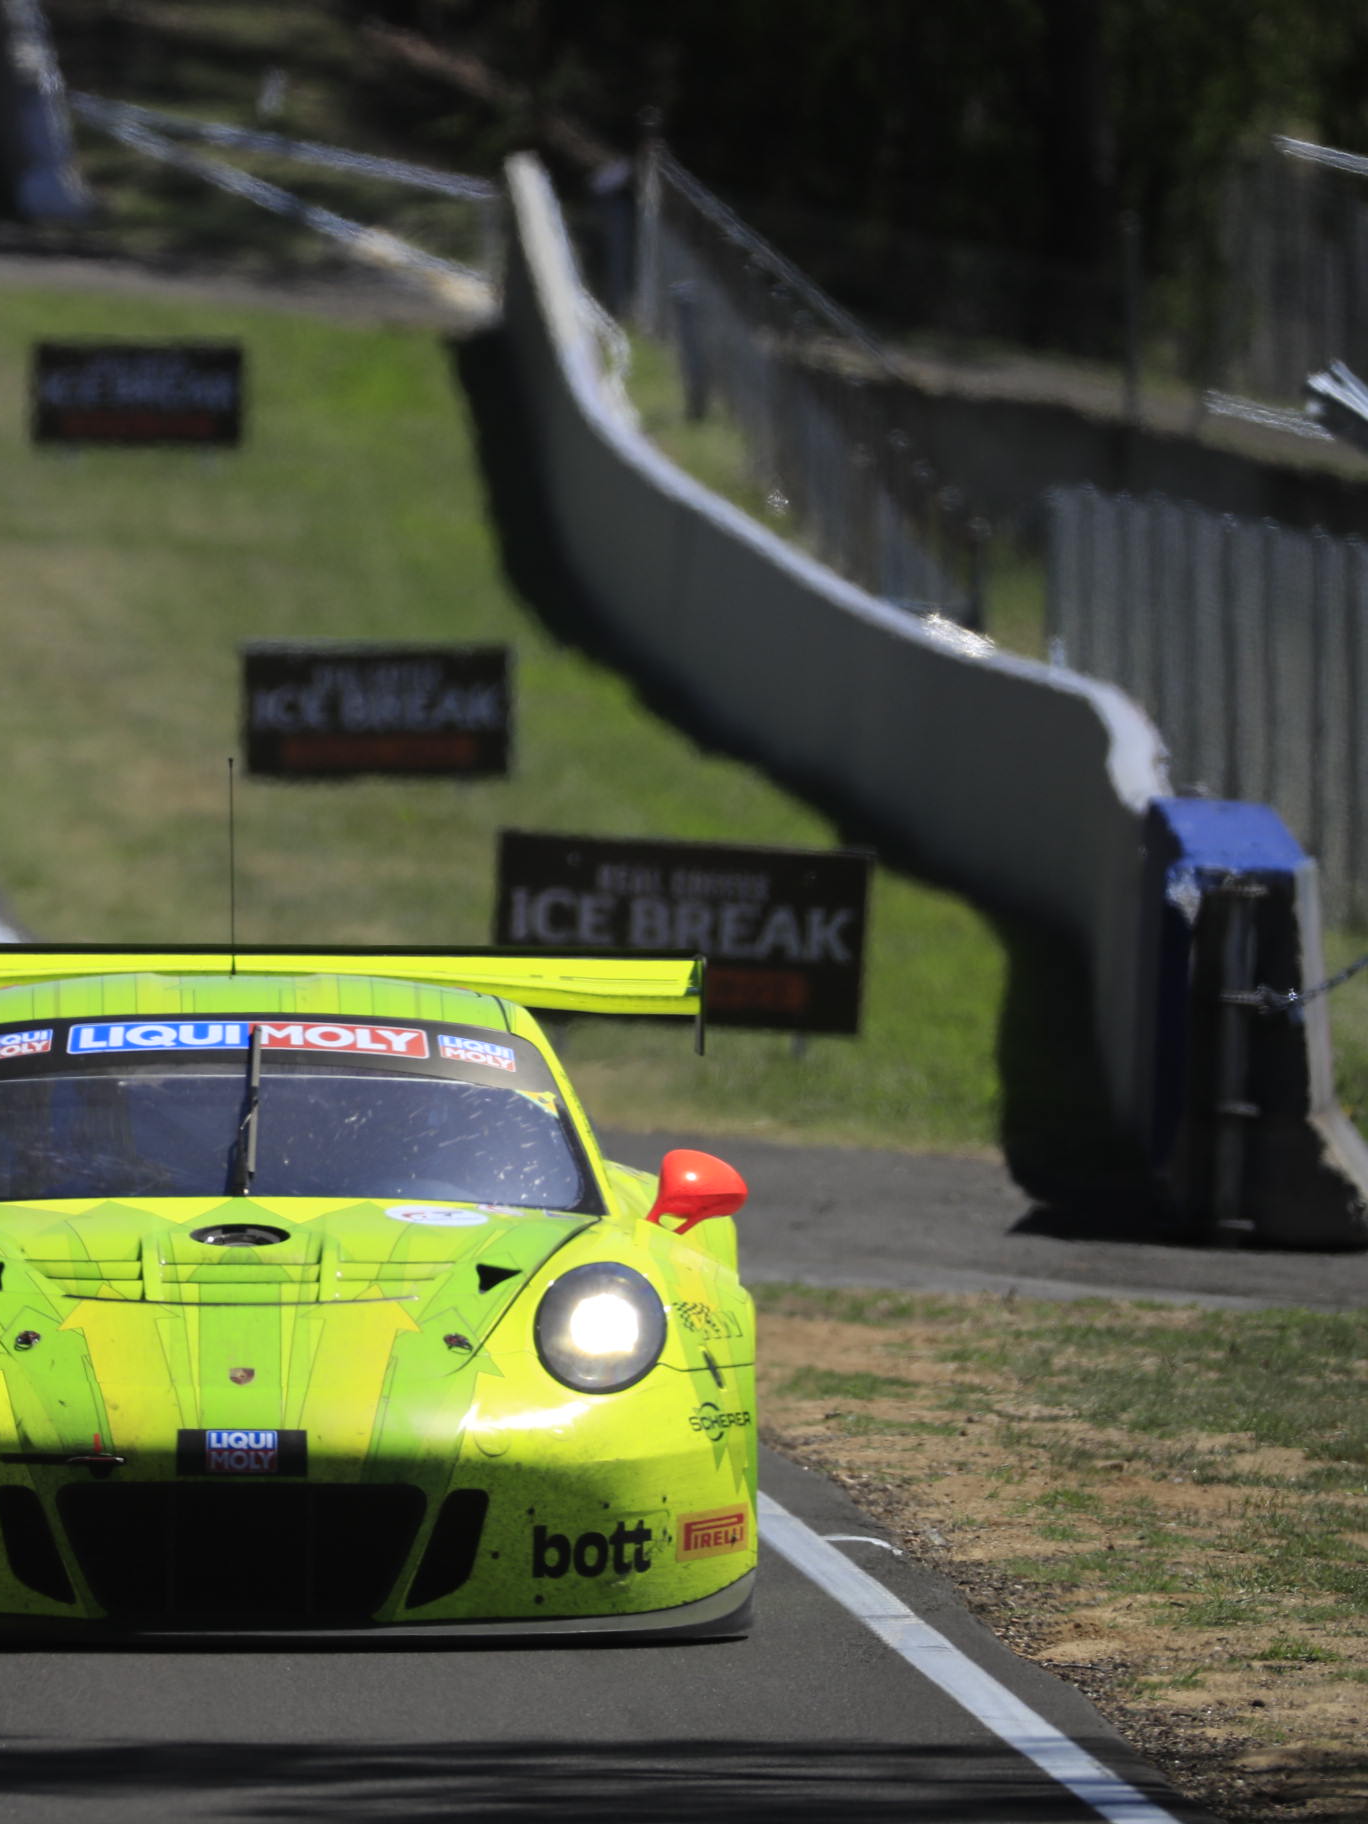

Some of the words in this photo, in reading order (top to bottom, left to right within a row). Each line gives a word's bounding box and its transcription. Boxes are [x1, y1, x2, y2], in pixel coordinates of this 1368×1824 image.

[508, 886, 616, 946] ICE
[628, 894, 854, 964] BREAK
[78, 1024, 241, 1048] LIQUI
[259, 1024, 419, 1052] MOLY
[442, 1035, 514, 1058] LIQUI
[443, 1046, 514, 1069] MOLY
[211, 1431, 274, 1450] LIQUI
[211, 1450, 275, 1470] MOLY
[683, 1513, 745, 1551] PIRELLI
[533, 1519, 652, 1579] bott
